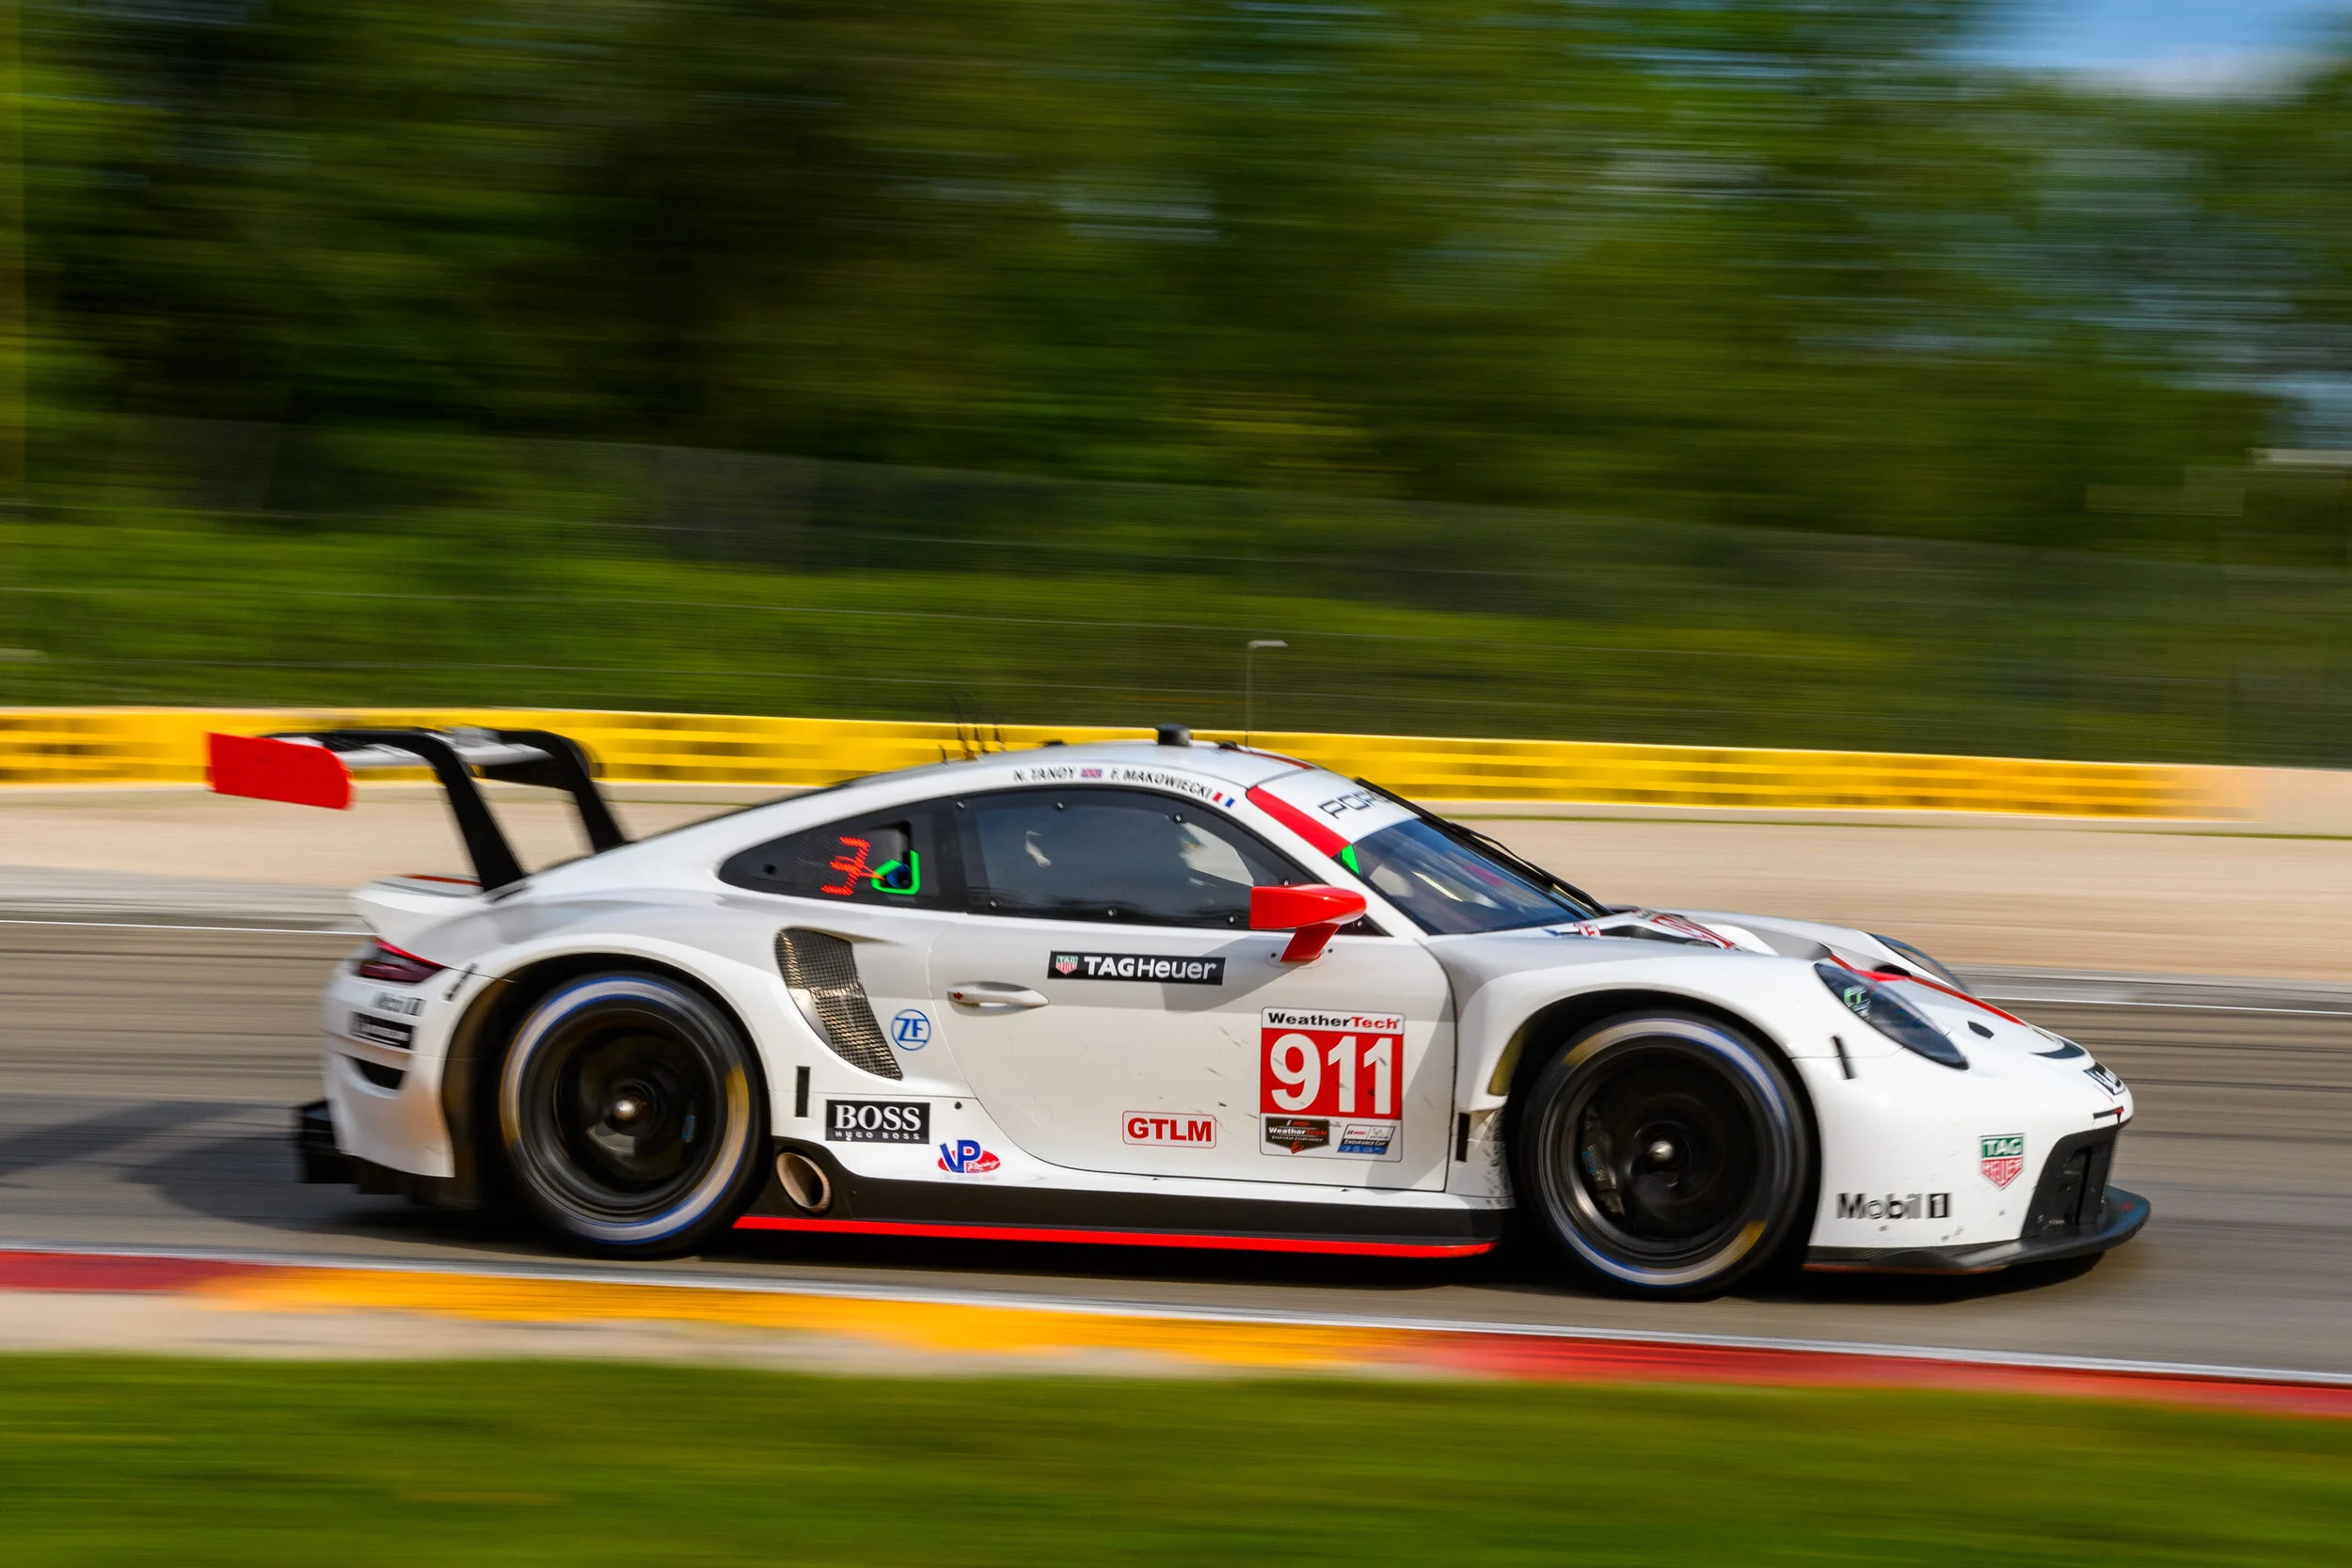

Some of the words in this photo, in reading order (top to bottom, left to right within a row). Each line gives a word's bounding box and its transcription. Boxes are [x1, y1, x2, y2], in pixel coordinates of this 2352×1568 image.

[1031, 767, 1076, 782] TANDY
[895, 1016, 929, 1043] ZF
[1268, 1012, 1399, 1030] WeatherTech
[1270, 1033, 1393, 1115] 911
[834, 1104, 922, 1132] BOSS
[1127, 1117, 1212, 1143] GTLM
[834, 1131, 874, 1139] HUGO
[882, 1132, 921, 1141] BOSS
[1982, 1137, 2023, 1157] TAG
[939, 1139, 981, 1174] VP
[1836, 1192, 1922, 1220] Mobil
[1926, 1192, 1951, 1219] 1
